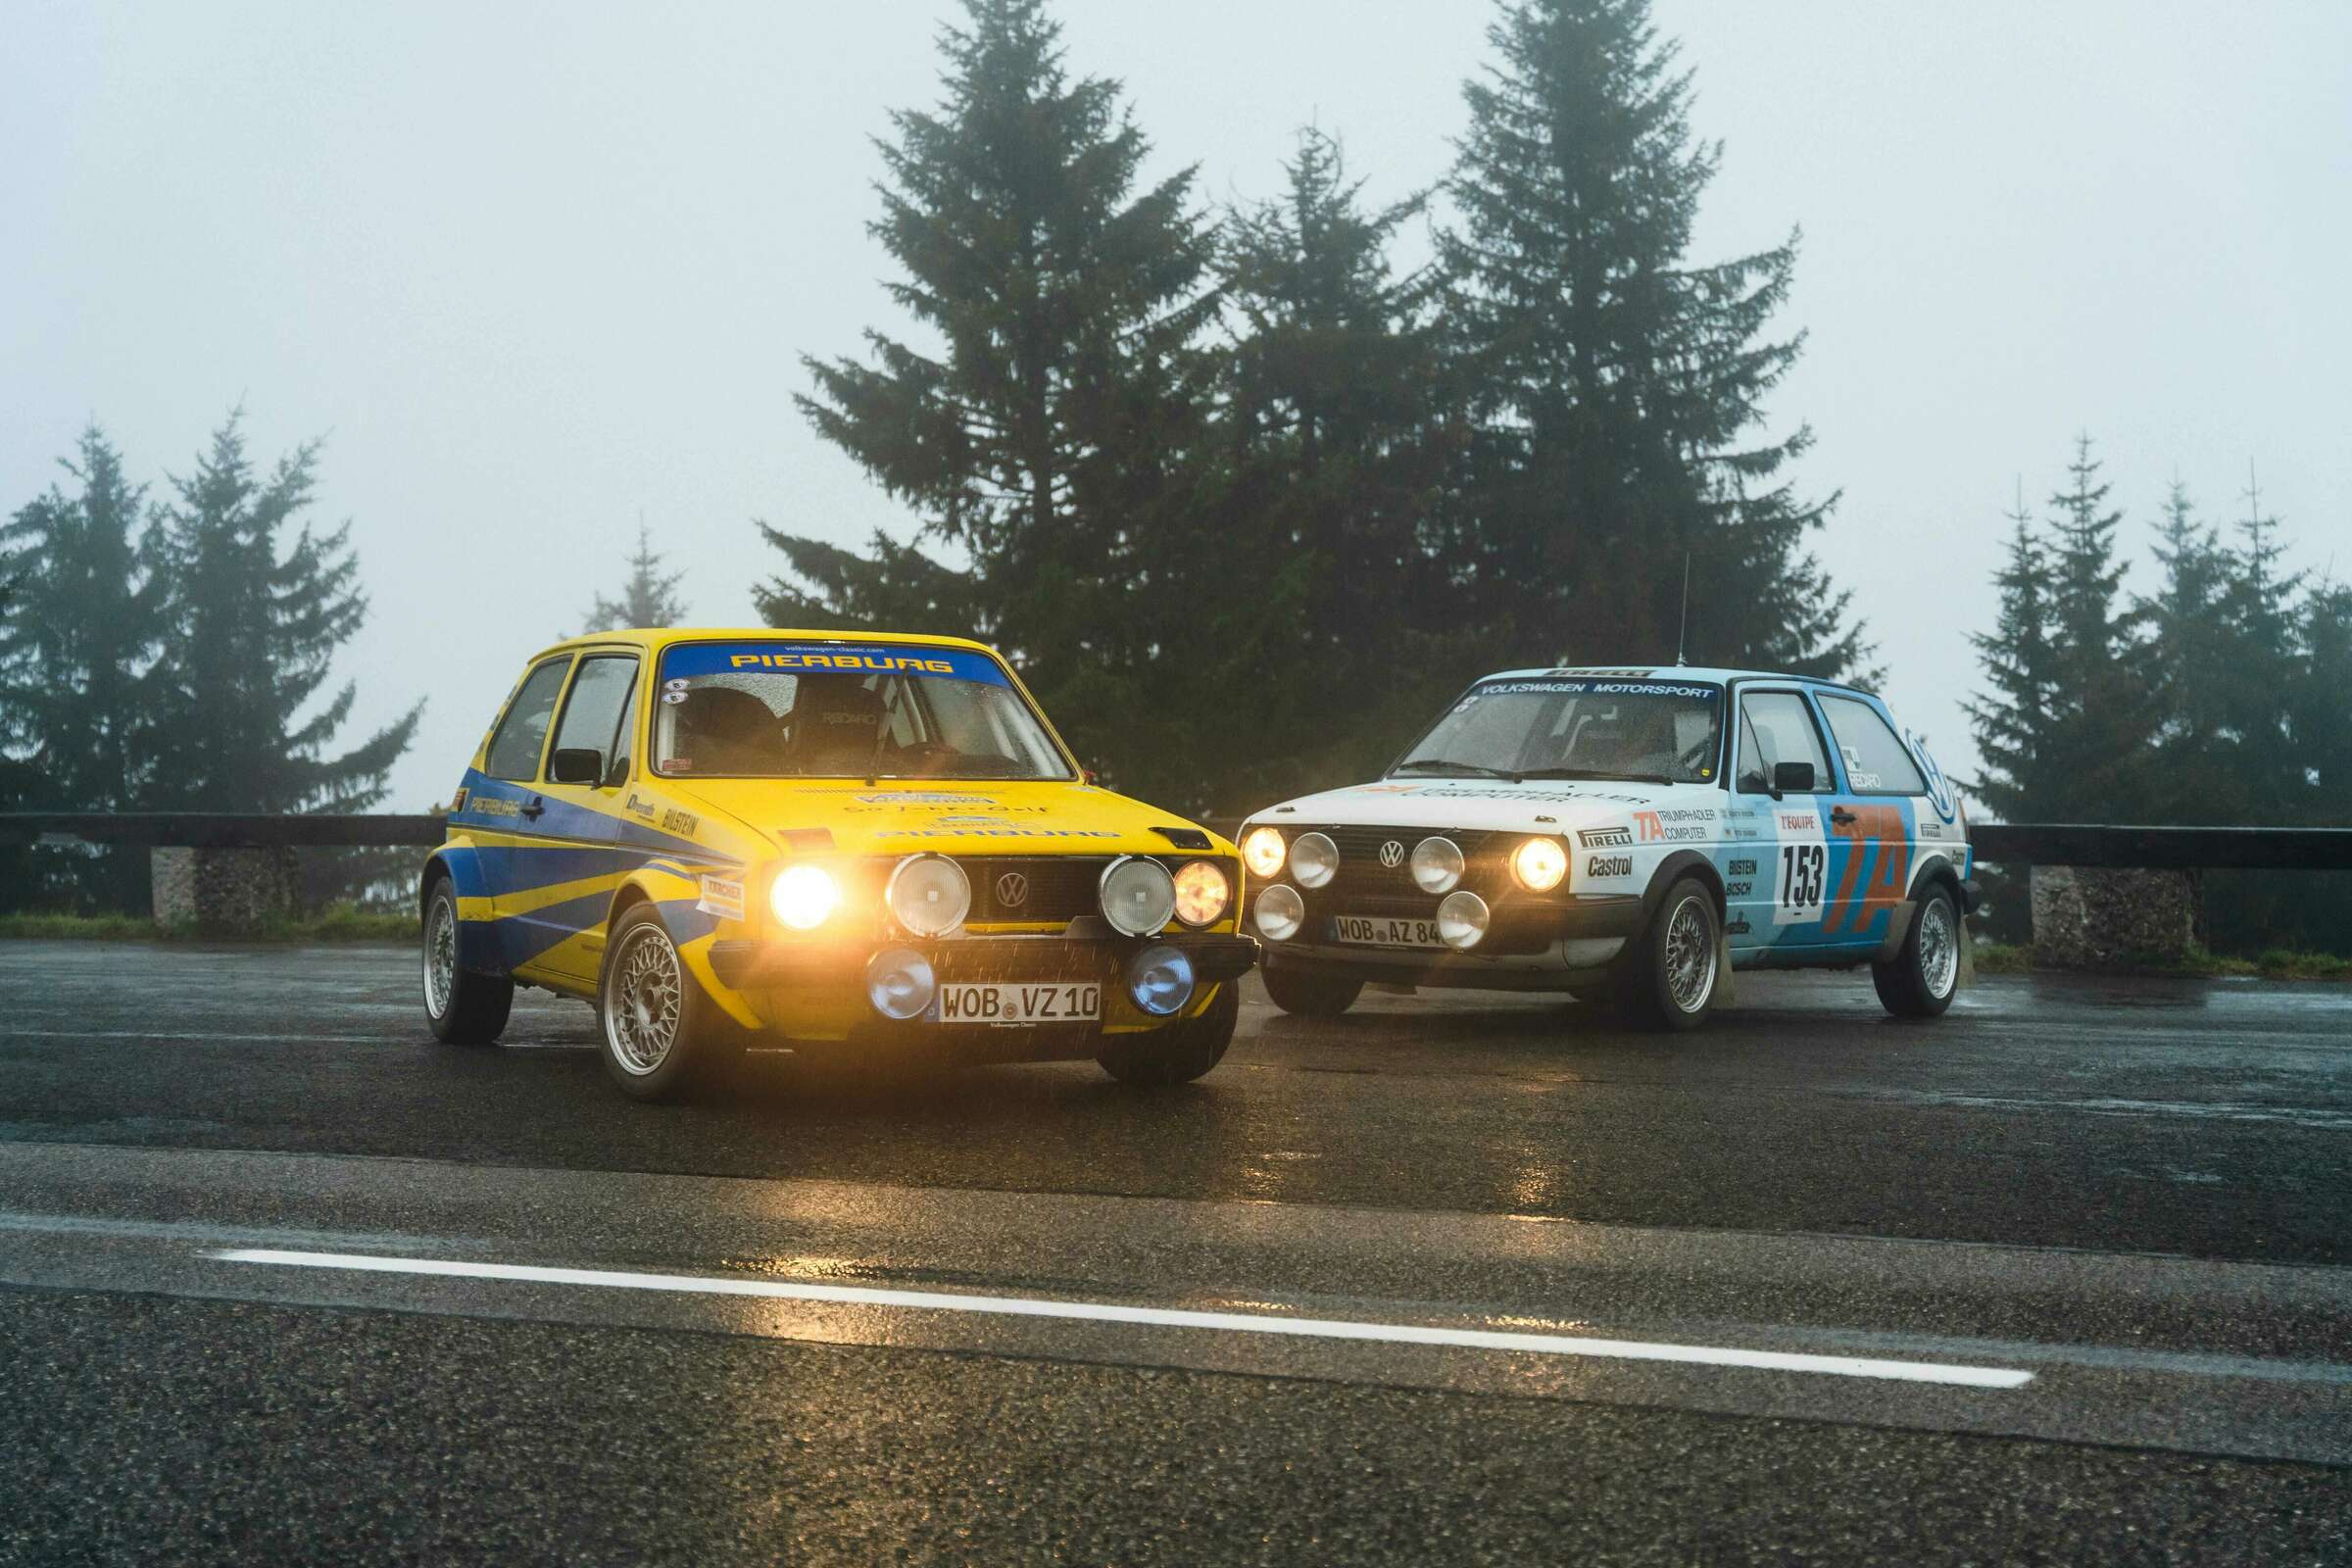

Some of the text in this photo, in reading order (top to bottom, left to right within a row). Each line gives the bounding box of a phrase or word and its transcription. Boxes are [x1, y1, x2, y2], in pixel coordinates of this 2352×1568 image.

[730, 655, 955, 673] PIERBURG
[1481, 683, 1714, 698] VOLKSWAGEN MOTORSPORT
[662, 808, 700, 838] BILSTEIN
[1632, 809, 1666, 842] TA
[1664, 826, 1708, 840] COMPUTER
[1576, 826, 1633, 848] PIRELLI
[1588, 856, 1633, 877] Castrol
[1783, 845, 1824, 908] 153
[1726, 882, 1752, 896] BOSCH
[1337, 917, 1374, 940] WOB
[1389, 921, 1413, 943] AZ
[943, 987, 1099, 1017] WOB VZ 10
